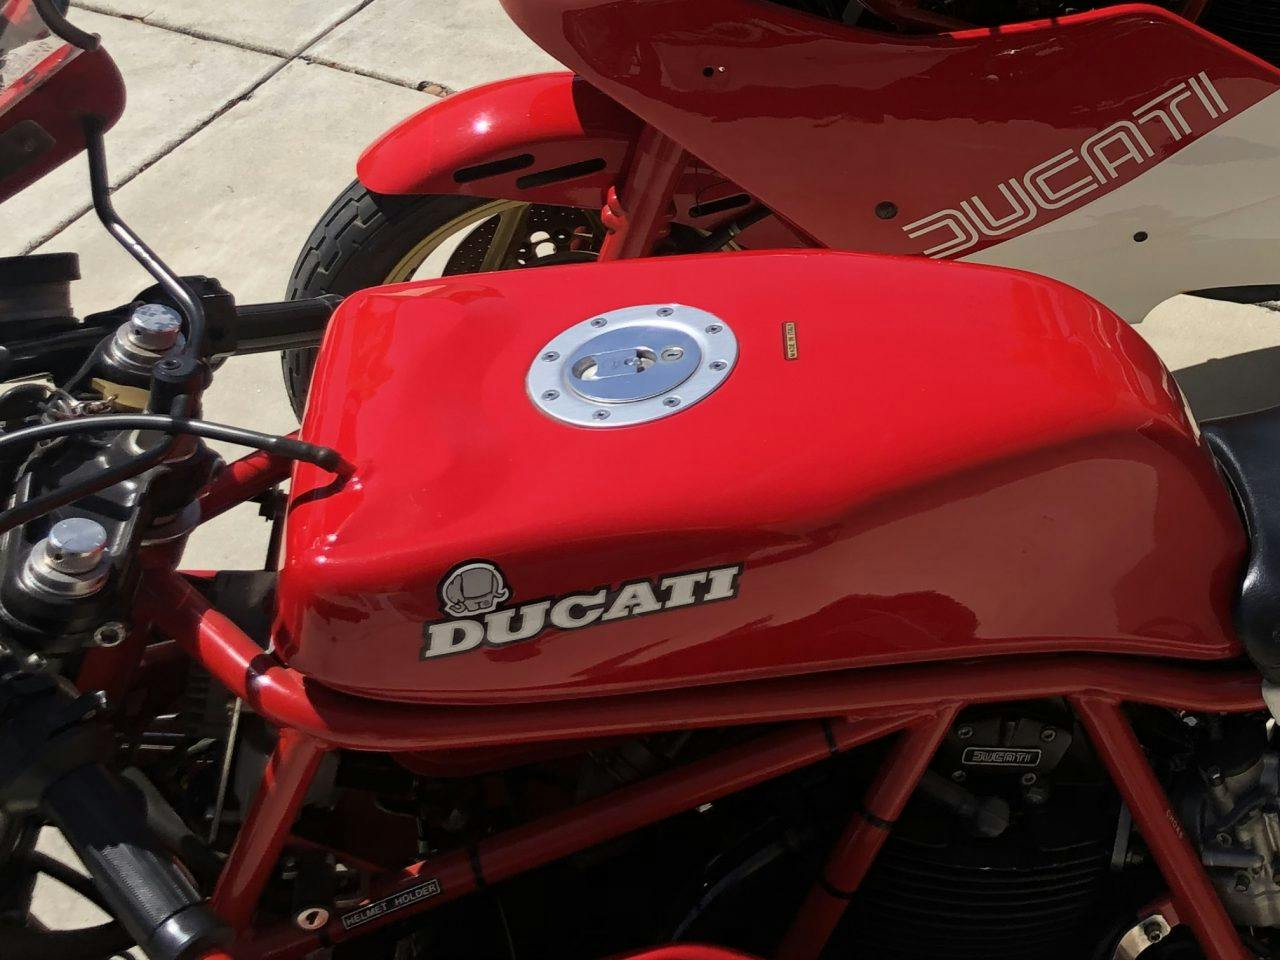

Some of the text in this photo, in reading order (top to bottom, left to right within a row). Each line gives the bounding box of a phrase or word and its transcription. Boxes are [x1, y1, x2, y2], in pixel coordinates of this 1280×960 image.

[902, 71, 1230, 260] DUCATI
[425, 566, 739, 658] DUCATI
[972, 750, 1032, 763] DUCATI
[346, 884, 437, 926] HELMET HOLDER
